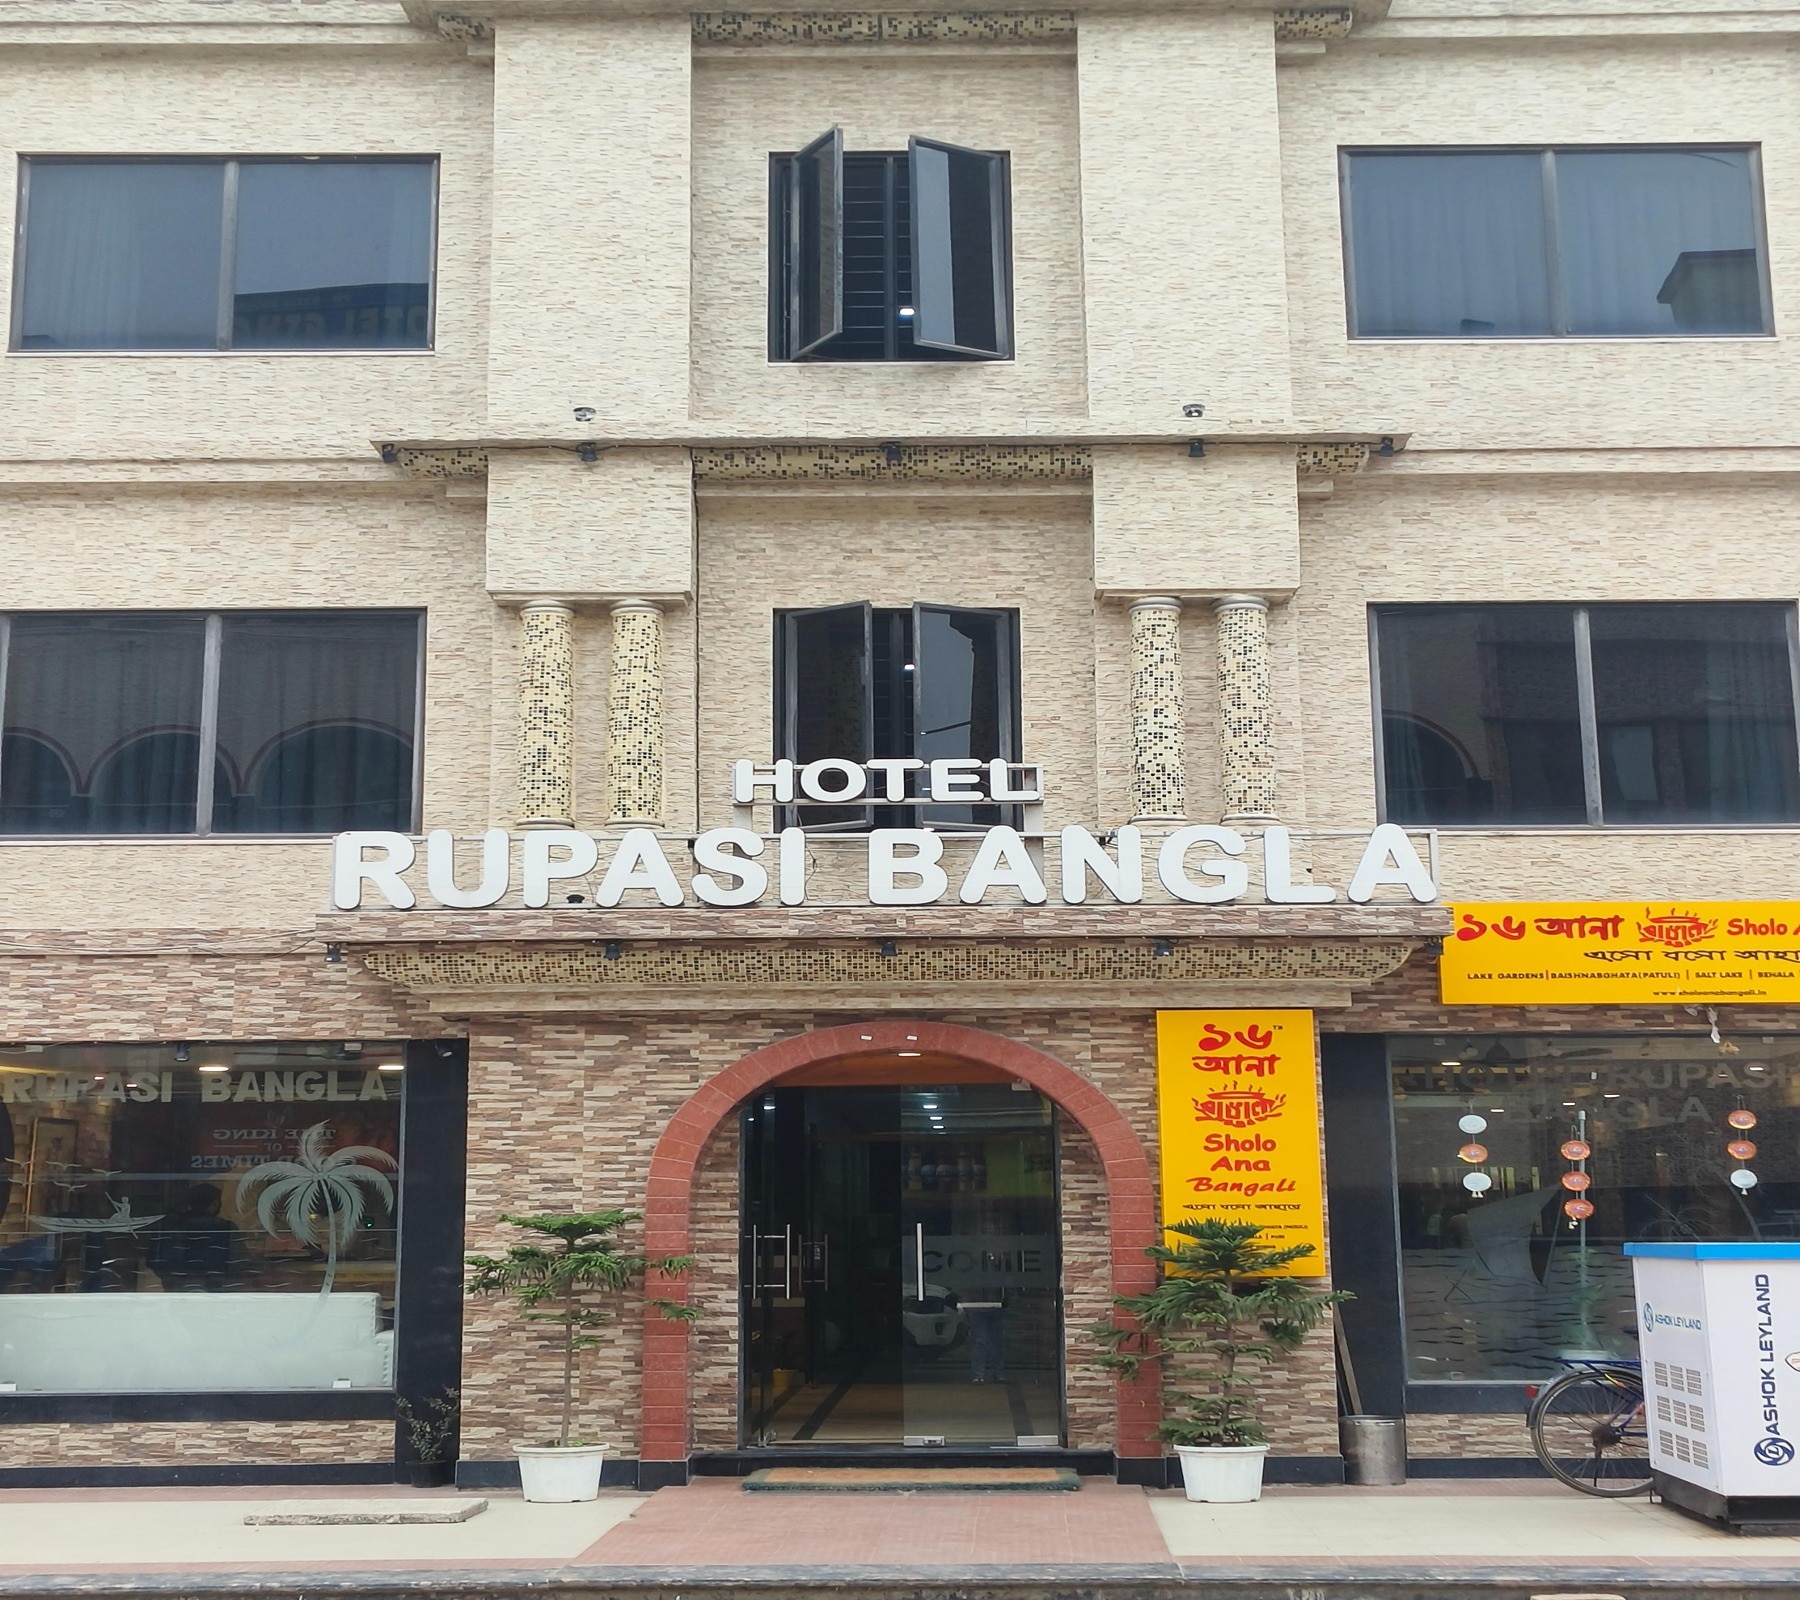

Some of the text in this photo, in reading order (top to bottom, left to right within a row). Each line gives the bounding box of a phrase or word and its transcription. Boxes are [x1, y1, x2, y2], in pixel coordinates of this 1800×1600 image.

[735, 758, 1040, 803] HOTEL
[334, 824, 1438, 909] RUPASI BANGLA
[1456, 914, 1526, 941] ১৬
[1534, 914, 1625, 941] আনা
[1726, 917, 1789, 936] Sholo
[1583, 950, 1653, 962] এসো
[1661, 950, 1727, 962] বসো
[1467, 972, 1493, 980] LAKE
[1695, 971, 1716, 979] SALT
[1719, 971, 1743, 979] LAKE
[1198, 1023, 1273, 1051] ১৬
[1192, 1054, 1281, 1077] আনা
[2, 1071, 388, 1103] RUPASI BANGLA
[1203, 1133, 1277, 1152] Sholo
[1210, 1156, 1271, 1172] Ana
[1186, 1177, 1297, 1197] Bangali
[1755, 1273, 1780, 1436] ASHOK LEYLAND
